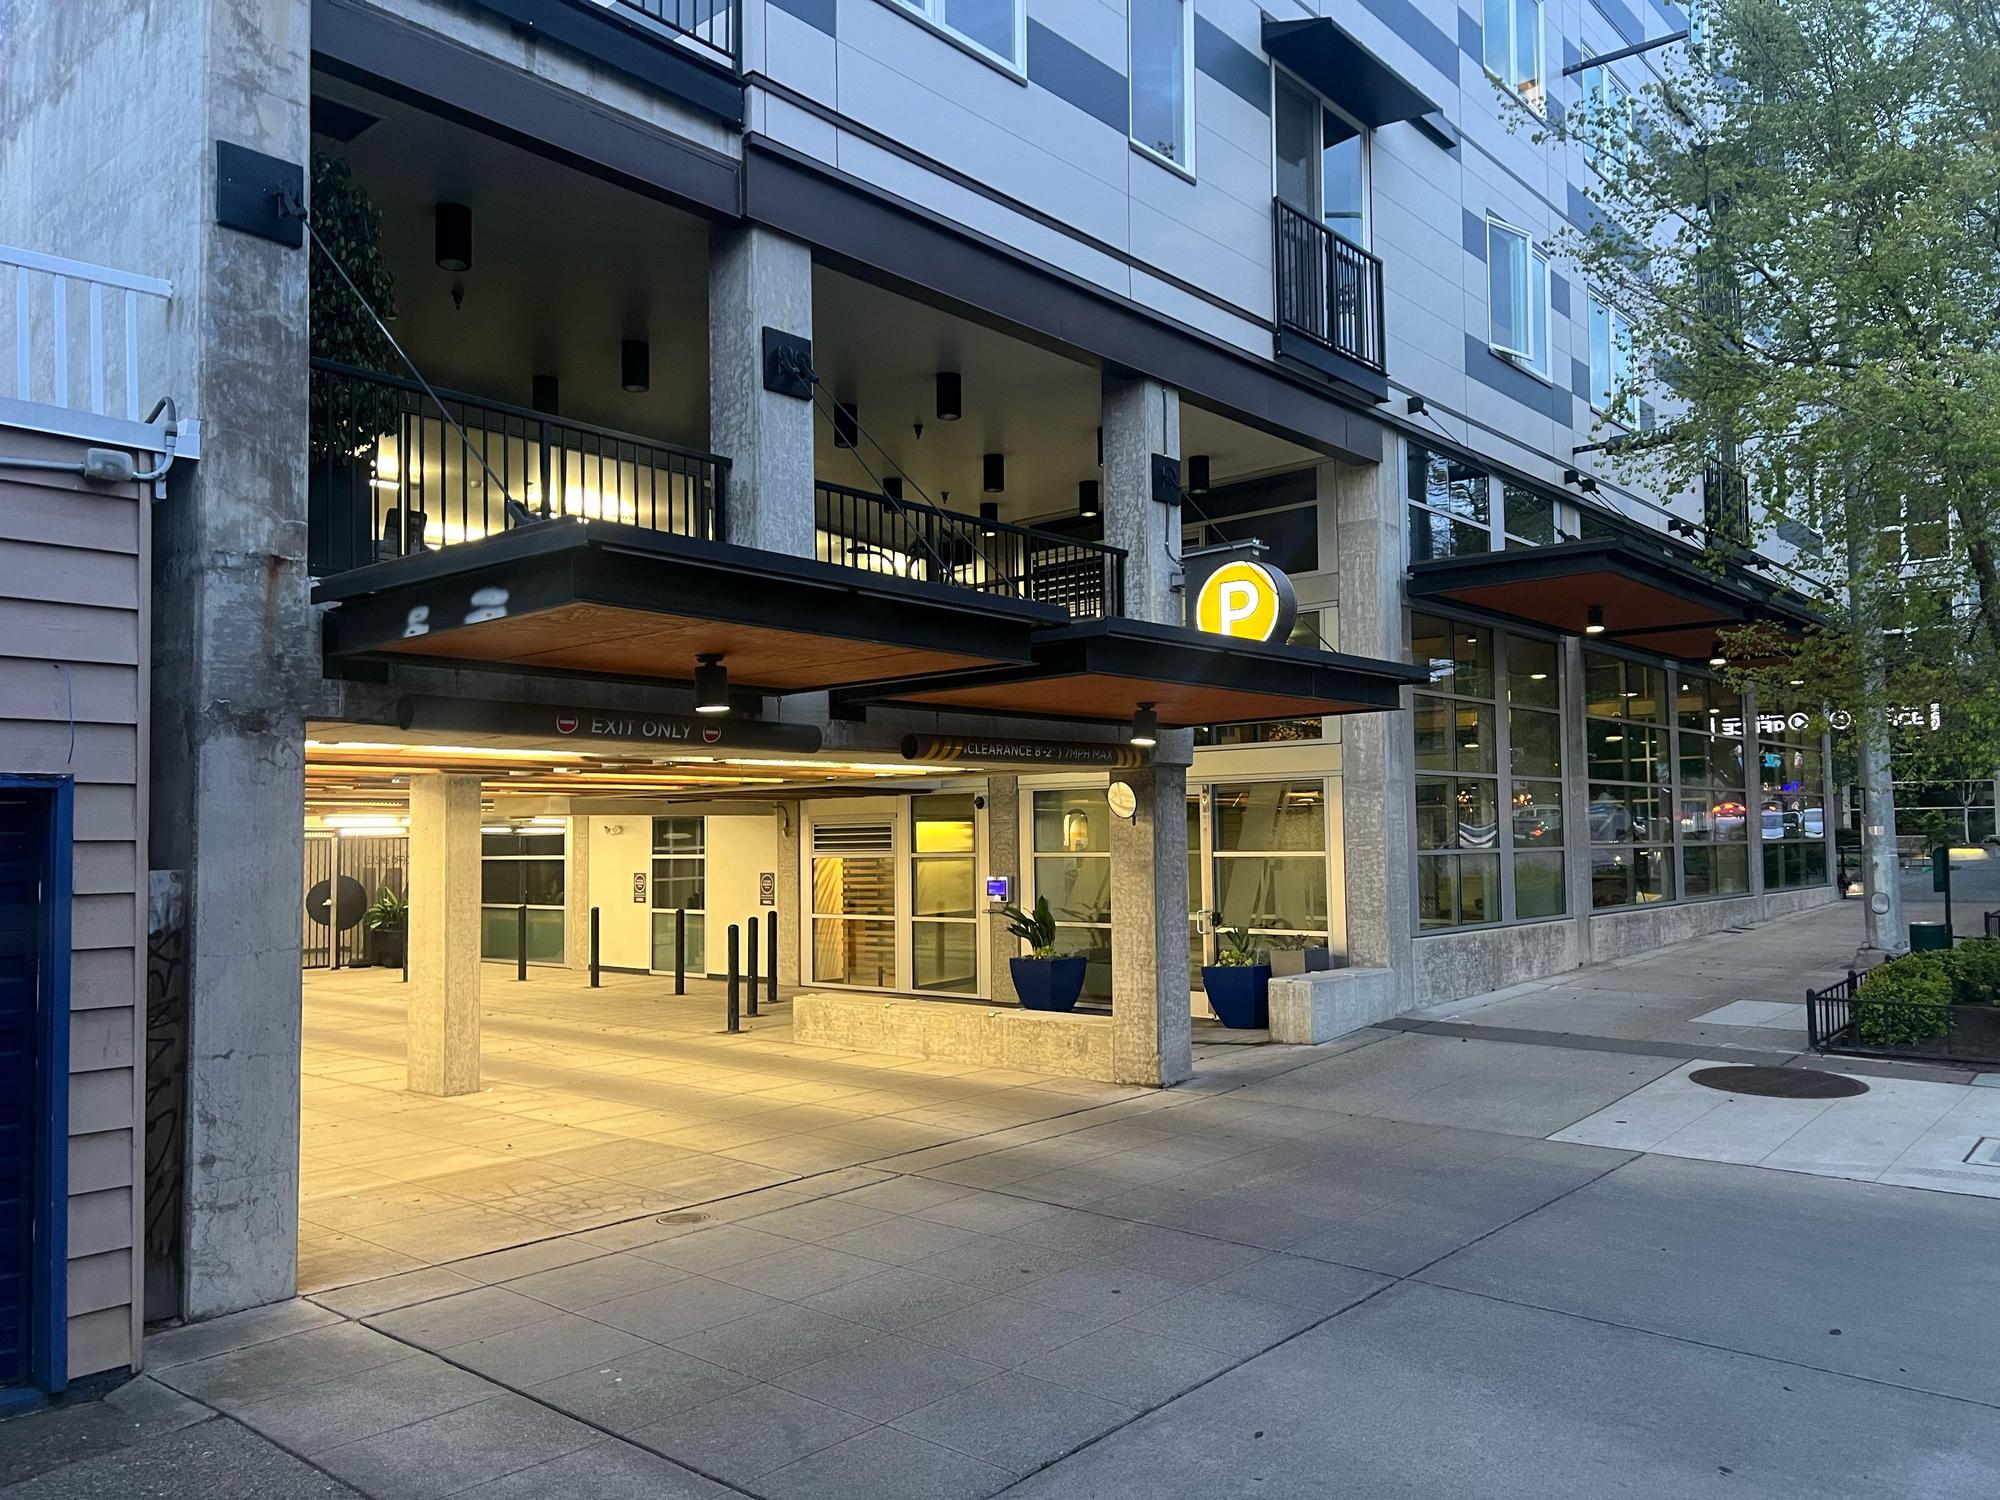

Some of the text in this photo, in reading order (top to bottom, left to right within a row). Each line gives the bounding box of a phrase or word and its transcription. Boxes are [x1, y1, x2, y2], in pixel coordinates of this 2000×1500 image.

[1220, 580, 1259, 635] P
[591, 717, 692, 739] EXIT ONLY
[967, 742, 1032, 757] CLEARANCE
[1092, 752, 1113, 760] MAX
